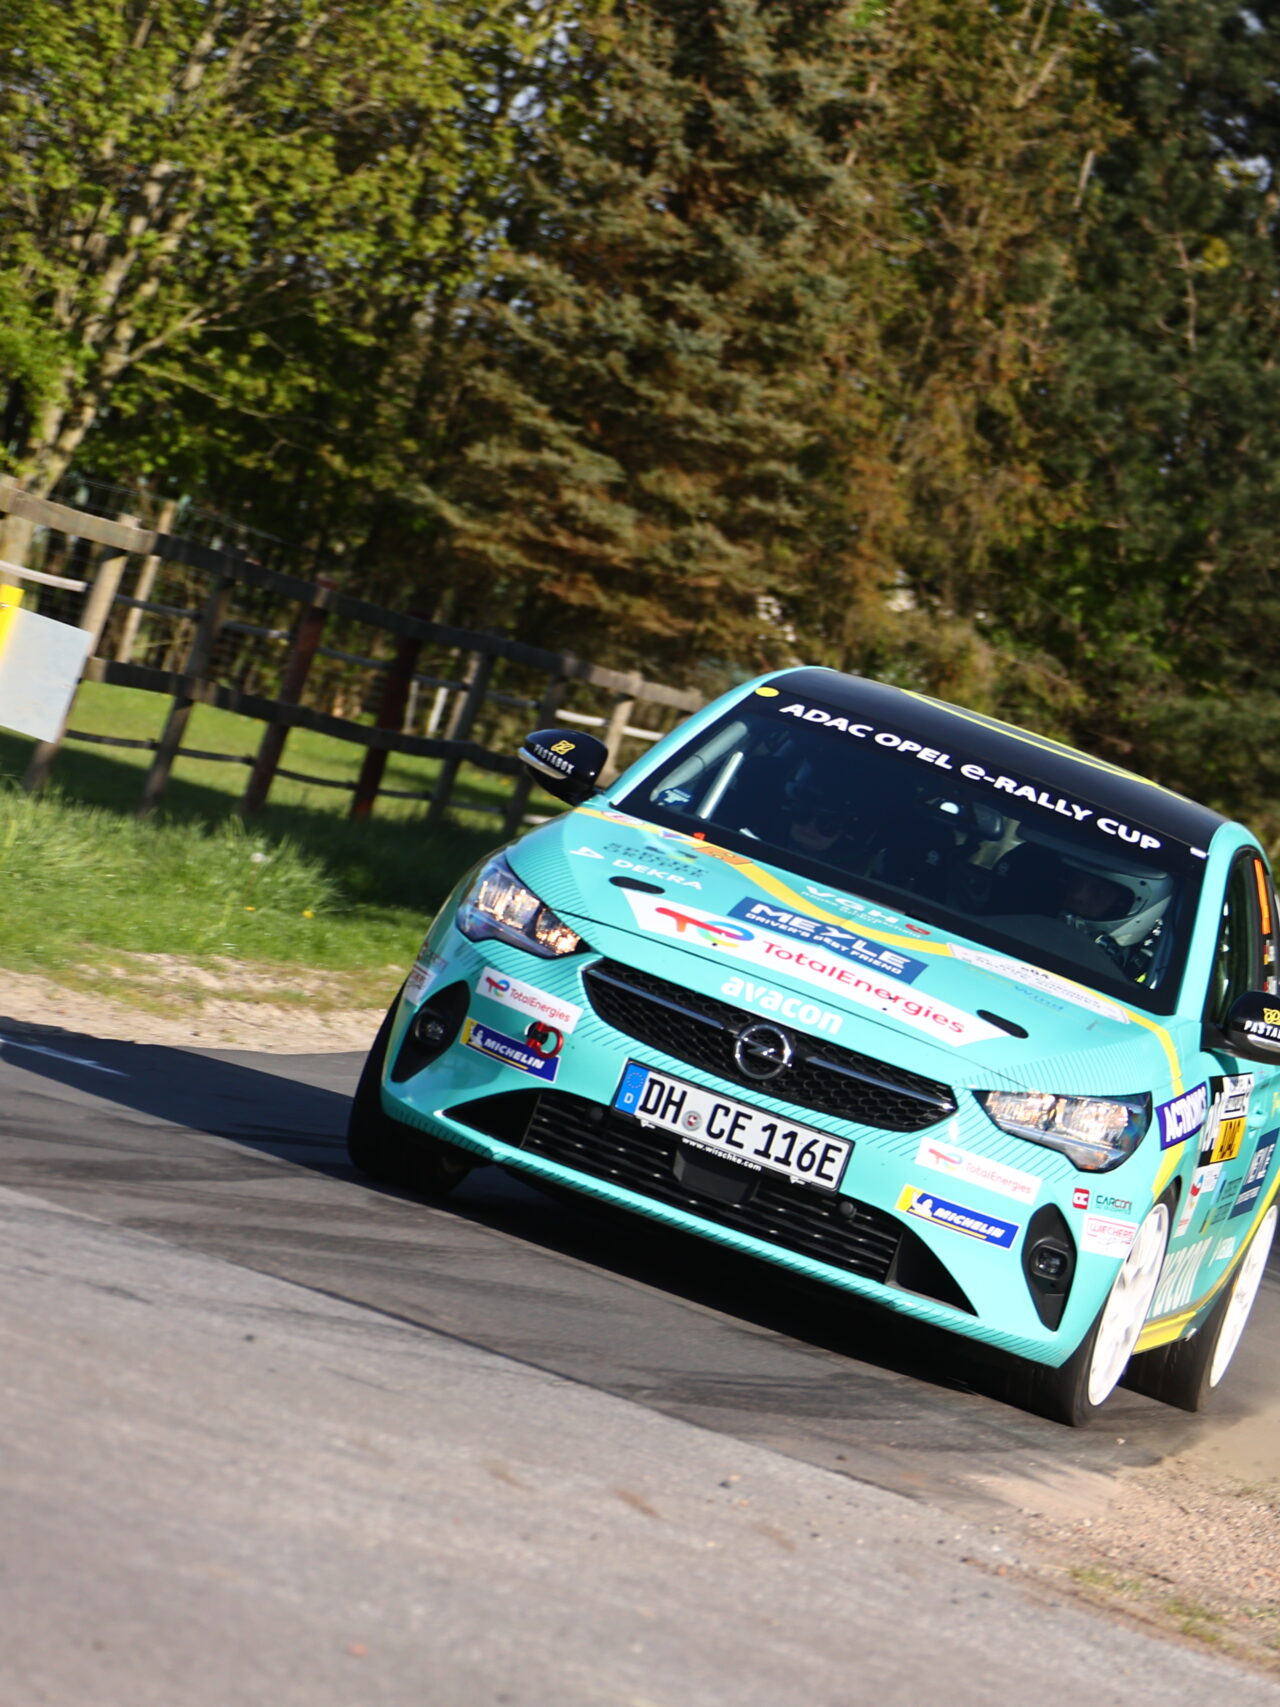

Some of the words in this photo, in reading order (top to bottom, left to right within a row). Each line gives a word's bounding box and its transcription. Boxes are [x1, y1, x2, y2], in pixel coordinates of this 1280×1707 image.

[779, 704, 874, 738] ADAC
[875, 733, 953, 770] OPEL
[960, 764, 1094, 821] e-RALLY
[1097, 818, 1161, 849] CUP
[612, 859, 703, 890] DEKRA
[806, 885, 900, 923] VGH
[745, 912, 811, 938] DRIVER'S
[813, 935, 850, 953] BEST
[850, 950, 903, 975] FRIEND
[751, 903, 911, 969] MEYLE
[510, 988, 571, 1022] TotalEnergies
[720, 975, 843, 1036] avacon
[762, 941, 965, 1033] TotalEnergies
[483, 1038, 545, 1069] MICHELIN
[624, 1092, 634, 1104] D
[638, 1078, 687, 1124] DH
[706, 1103, 752, 1149] CE
[754, 1123, 843, 1182] 116E
[966, 1161, 1032, 1194] TotalEnergies
[933, 1206, 1005, 1238] MICHELIN
